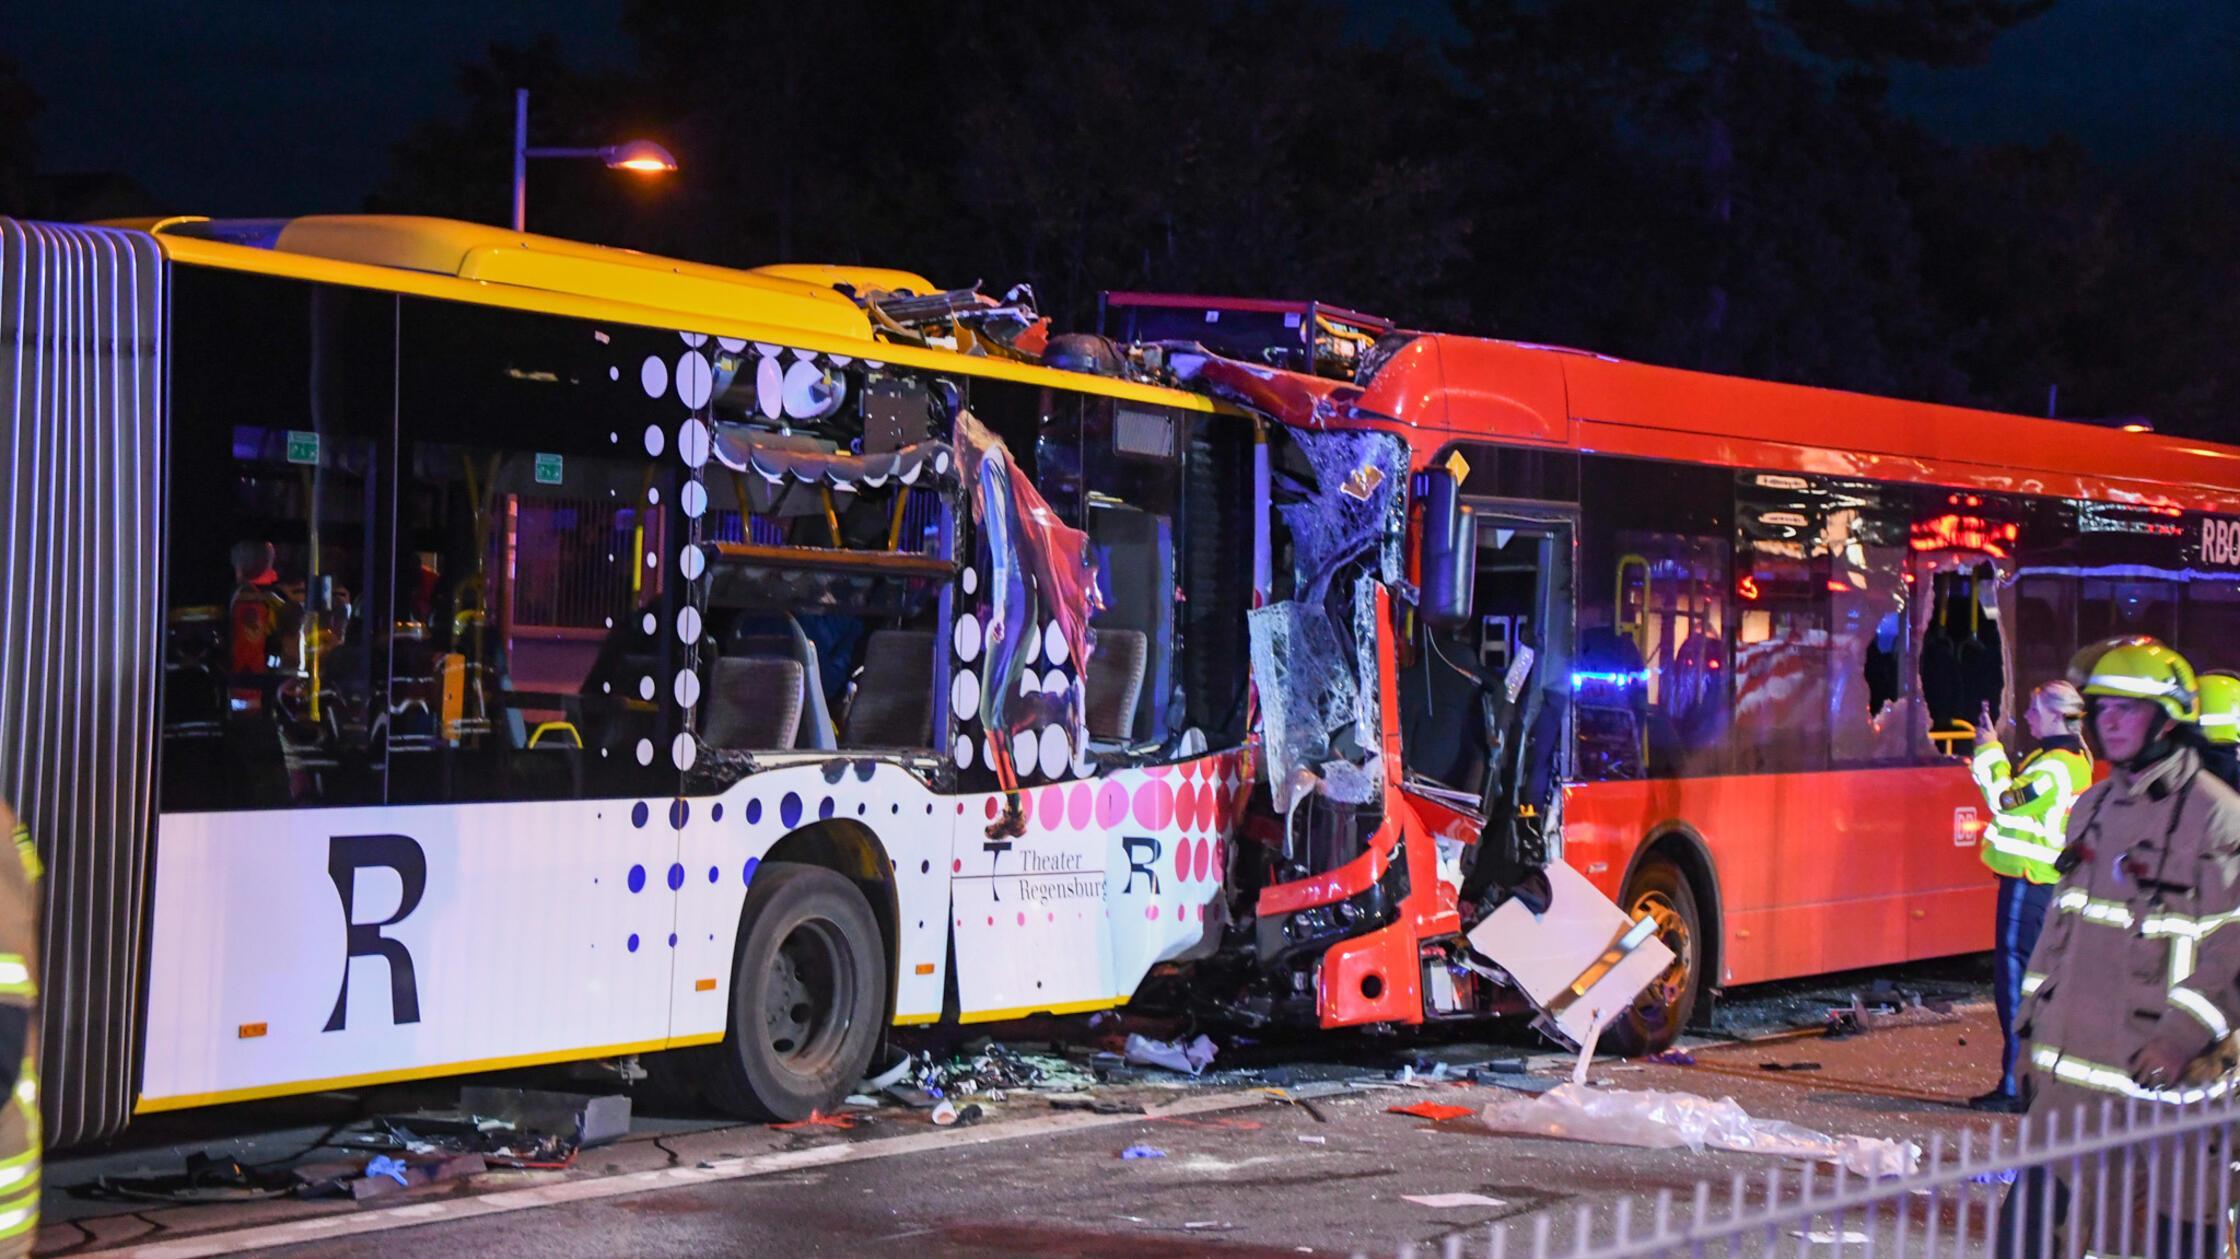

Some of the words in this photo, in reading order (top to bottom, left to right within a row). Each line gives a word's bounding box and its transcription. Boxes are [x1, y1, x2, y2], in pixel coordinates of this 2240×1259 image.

[2201, 517, 2240, 566] RBO
[1955, 809, 1976, 844] DB
[1020, 849, 1082, 872] Theater
[1122, 836, 1161, 895] R
[322, 834, 427, 1032] R
